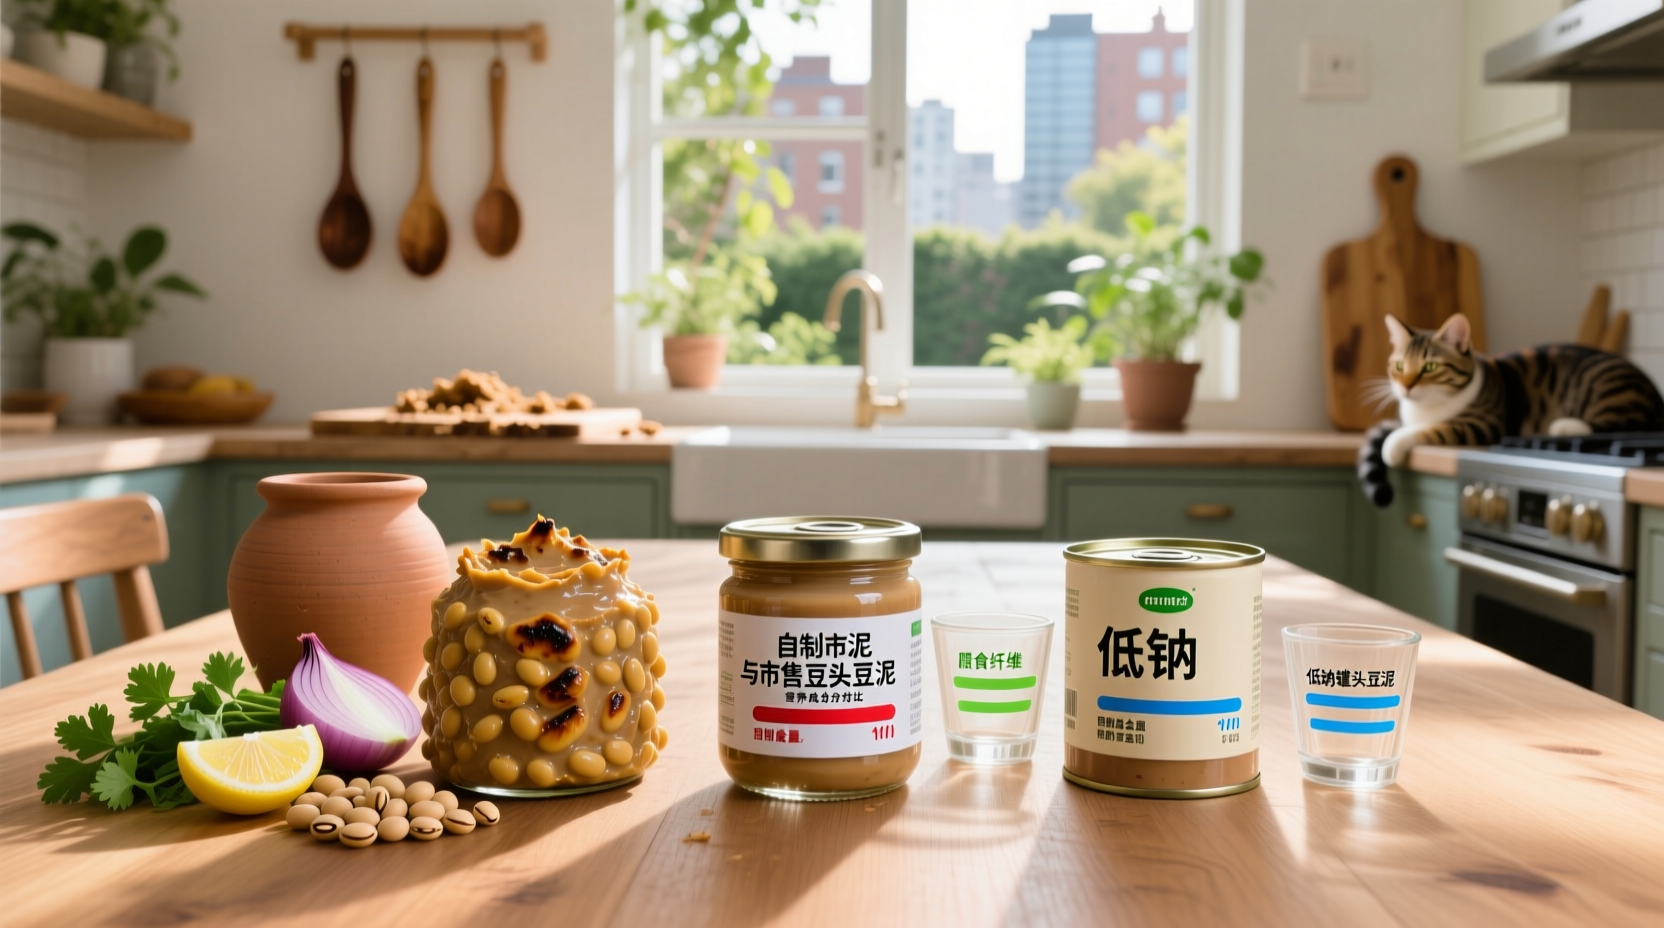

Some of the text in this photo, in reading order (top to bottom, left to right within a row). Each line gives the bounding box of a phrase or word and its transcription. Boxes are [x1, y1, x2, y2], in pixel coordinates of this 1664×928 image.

[778, 632, 872, 659] 自制市泥
[1097, 625, 1197, 680] 低钠
[740, 659, 896, 689] 与市售豆头豆泥
